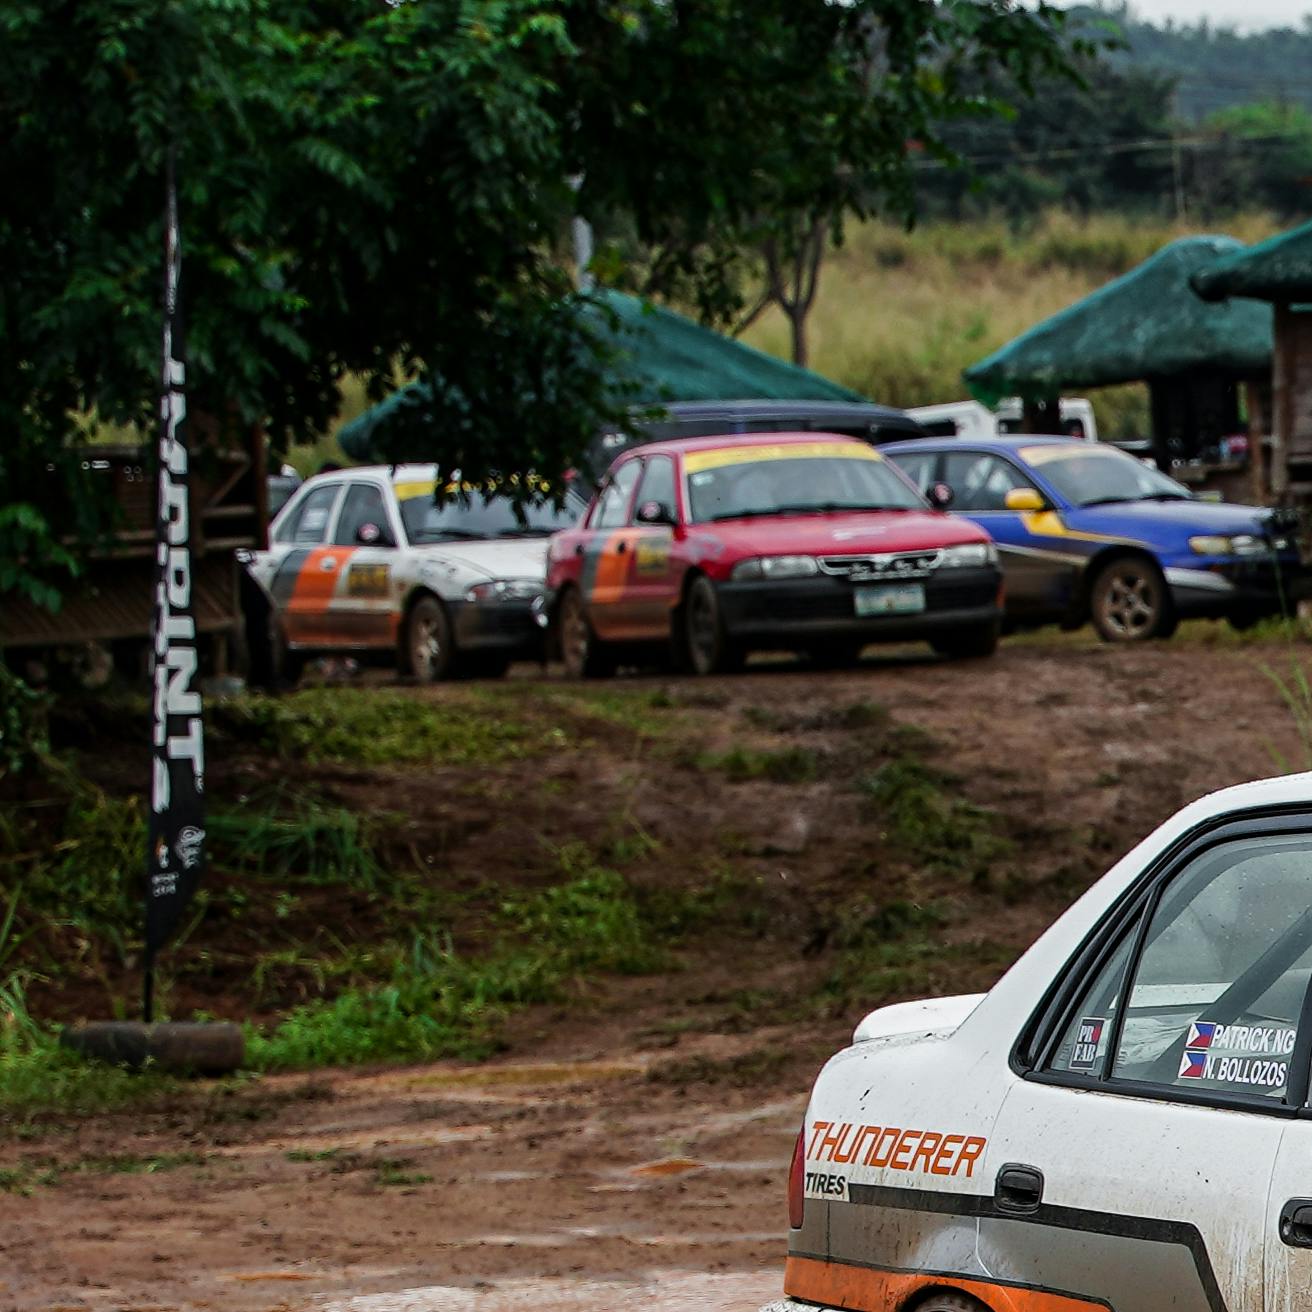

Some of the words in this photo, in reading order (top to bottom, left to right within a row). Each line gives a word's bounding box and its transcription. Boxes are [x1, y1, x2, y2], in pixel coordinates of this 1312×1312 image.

[1073, 1043, 1097, 1062] FAB
[1210, 1024, 1274, 1053] PATRICK
[1271, 1029, 1297, 1054] NG
[1202, 1054, 1216, 1080] N.
[1217, 1056, 1287, 1087] BOLLOZOS
[806, 1120, 988, 1178] THUNDERER
[805, 1171, 847, 1196] TIRES
